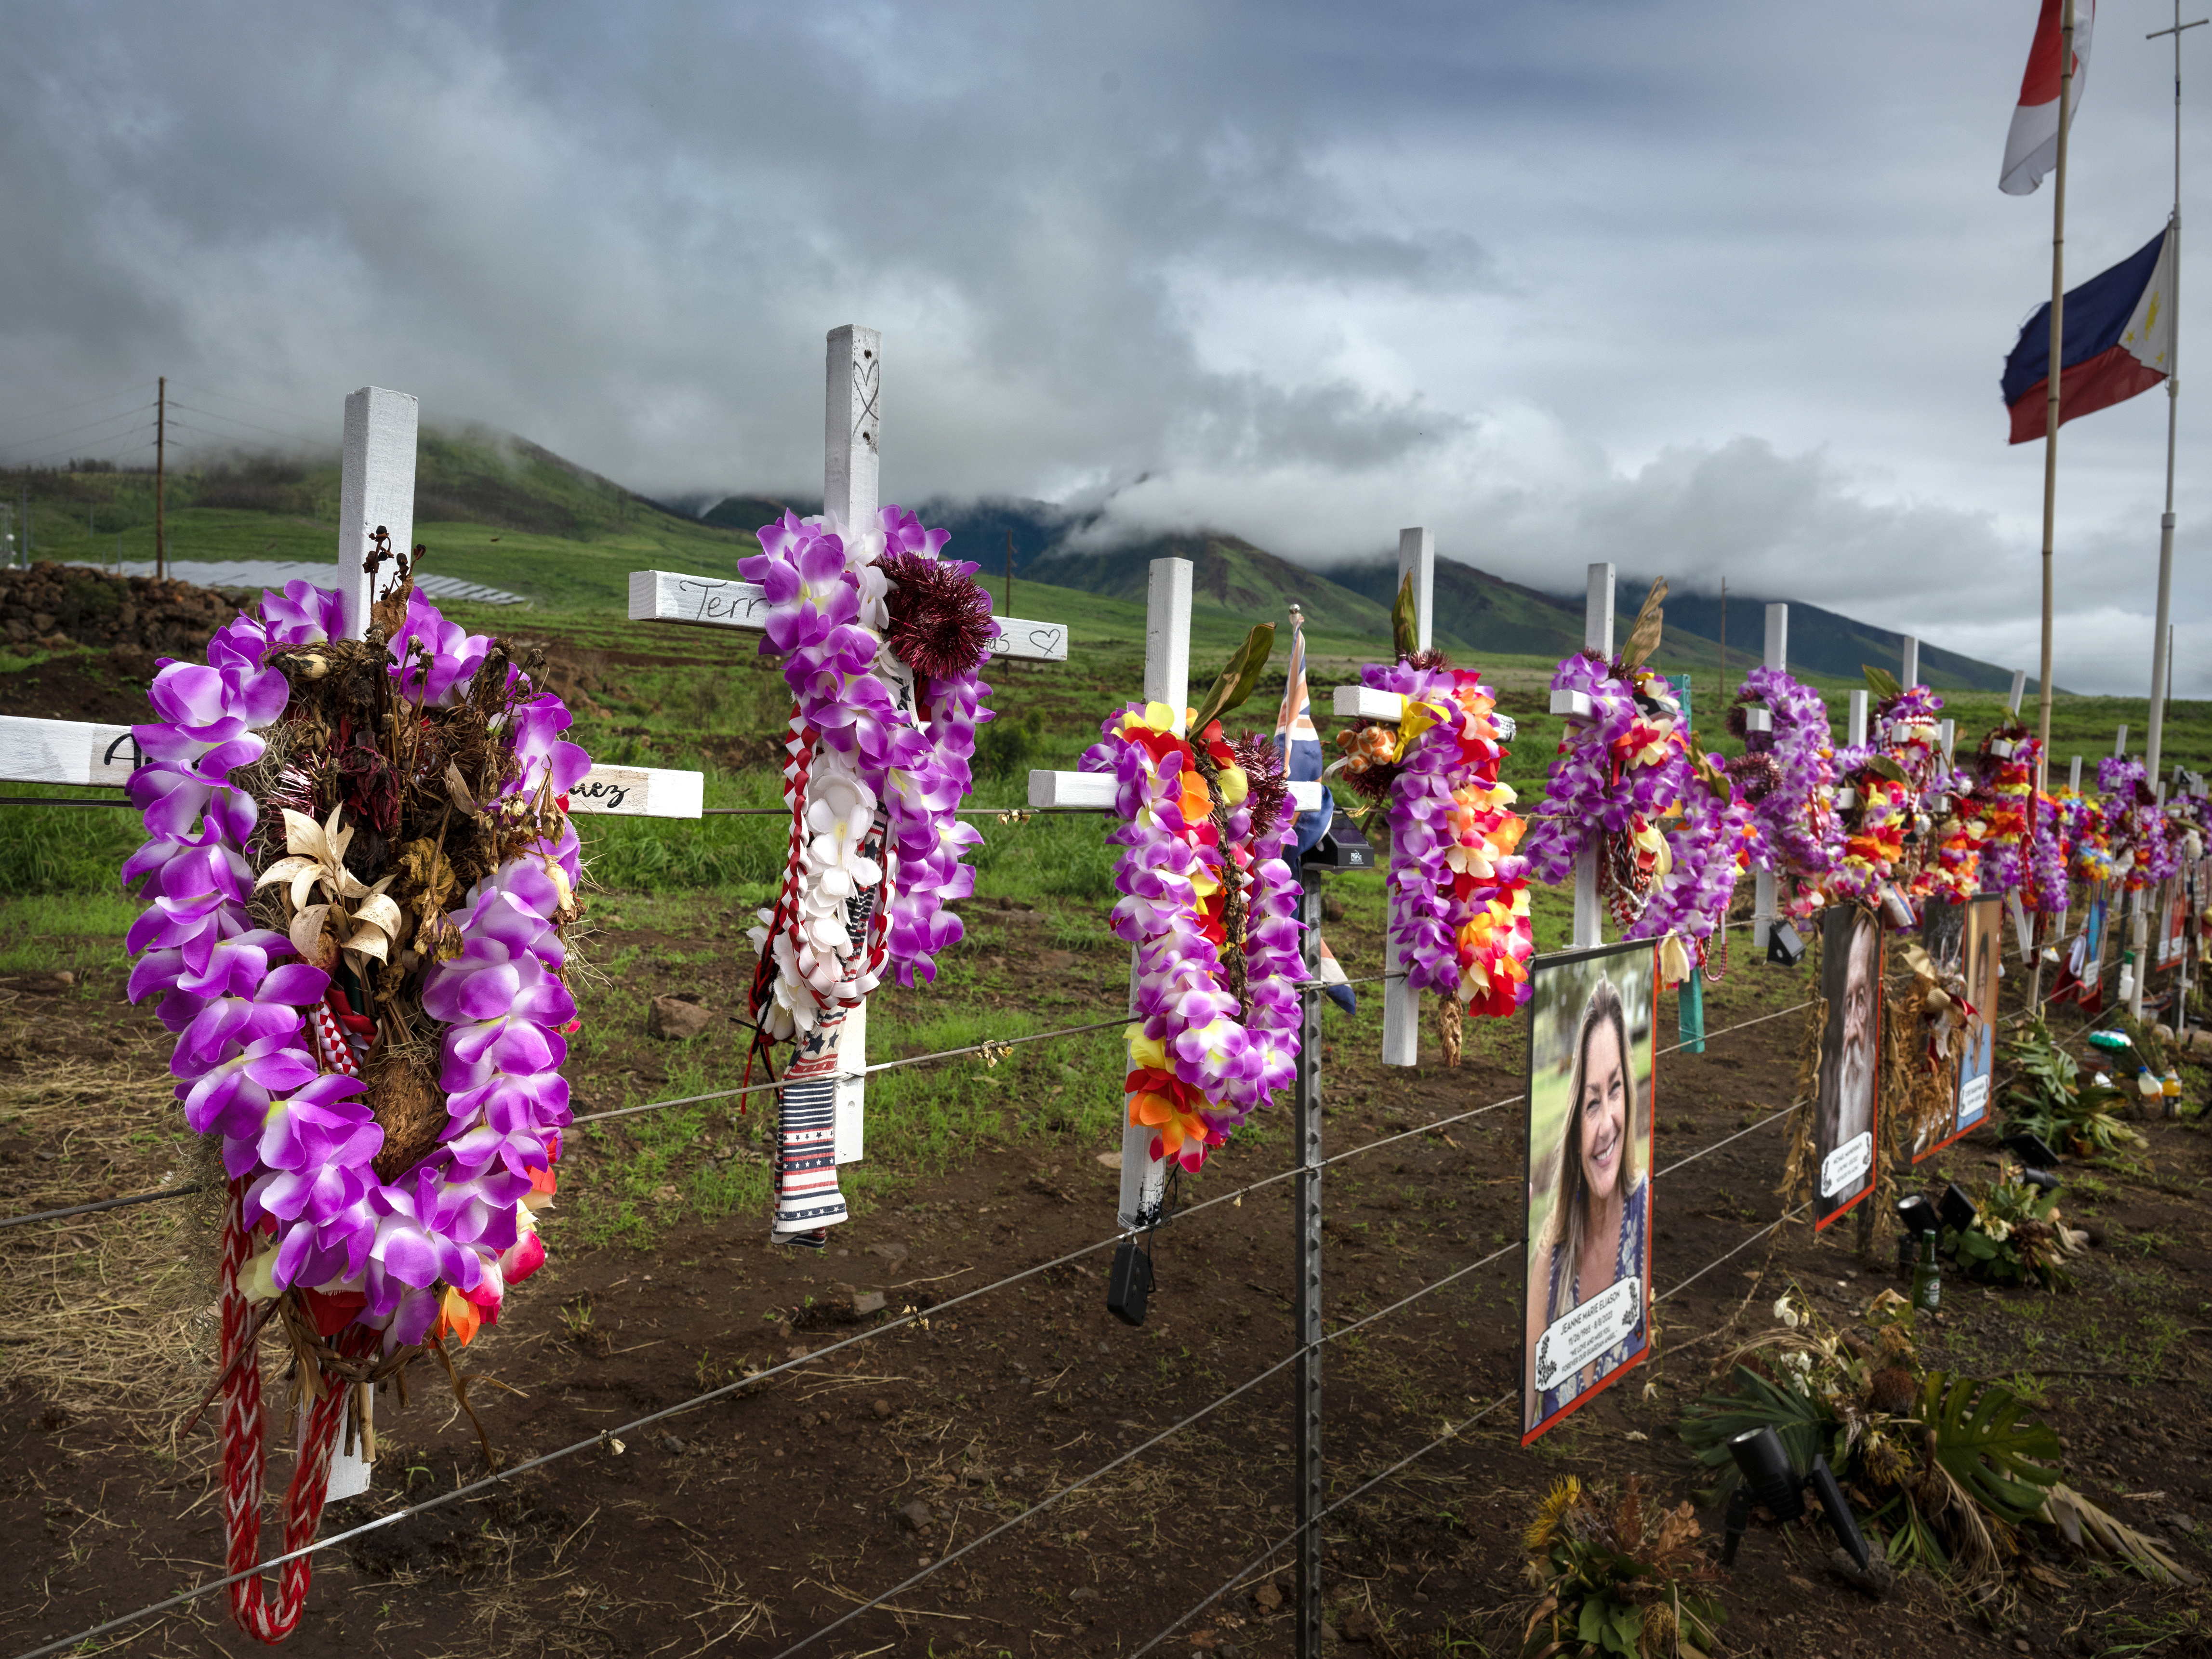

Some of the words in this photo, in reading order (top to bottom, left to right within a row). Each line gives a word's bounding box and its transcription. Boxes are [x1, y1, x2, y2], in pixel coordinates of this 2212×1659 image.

[679, 580, 772, 621] Terr
[985, 633, 1010, 652] as
[569, 782, 631, 809] uez
[1561, 1314, 1581, 1335] JEANNE
[1582, 1302, 1598, 1321] MARIE
[1599, 1289, 1620, 1310] ELIASON
